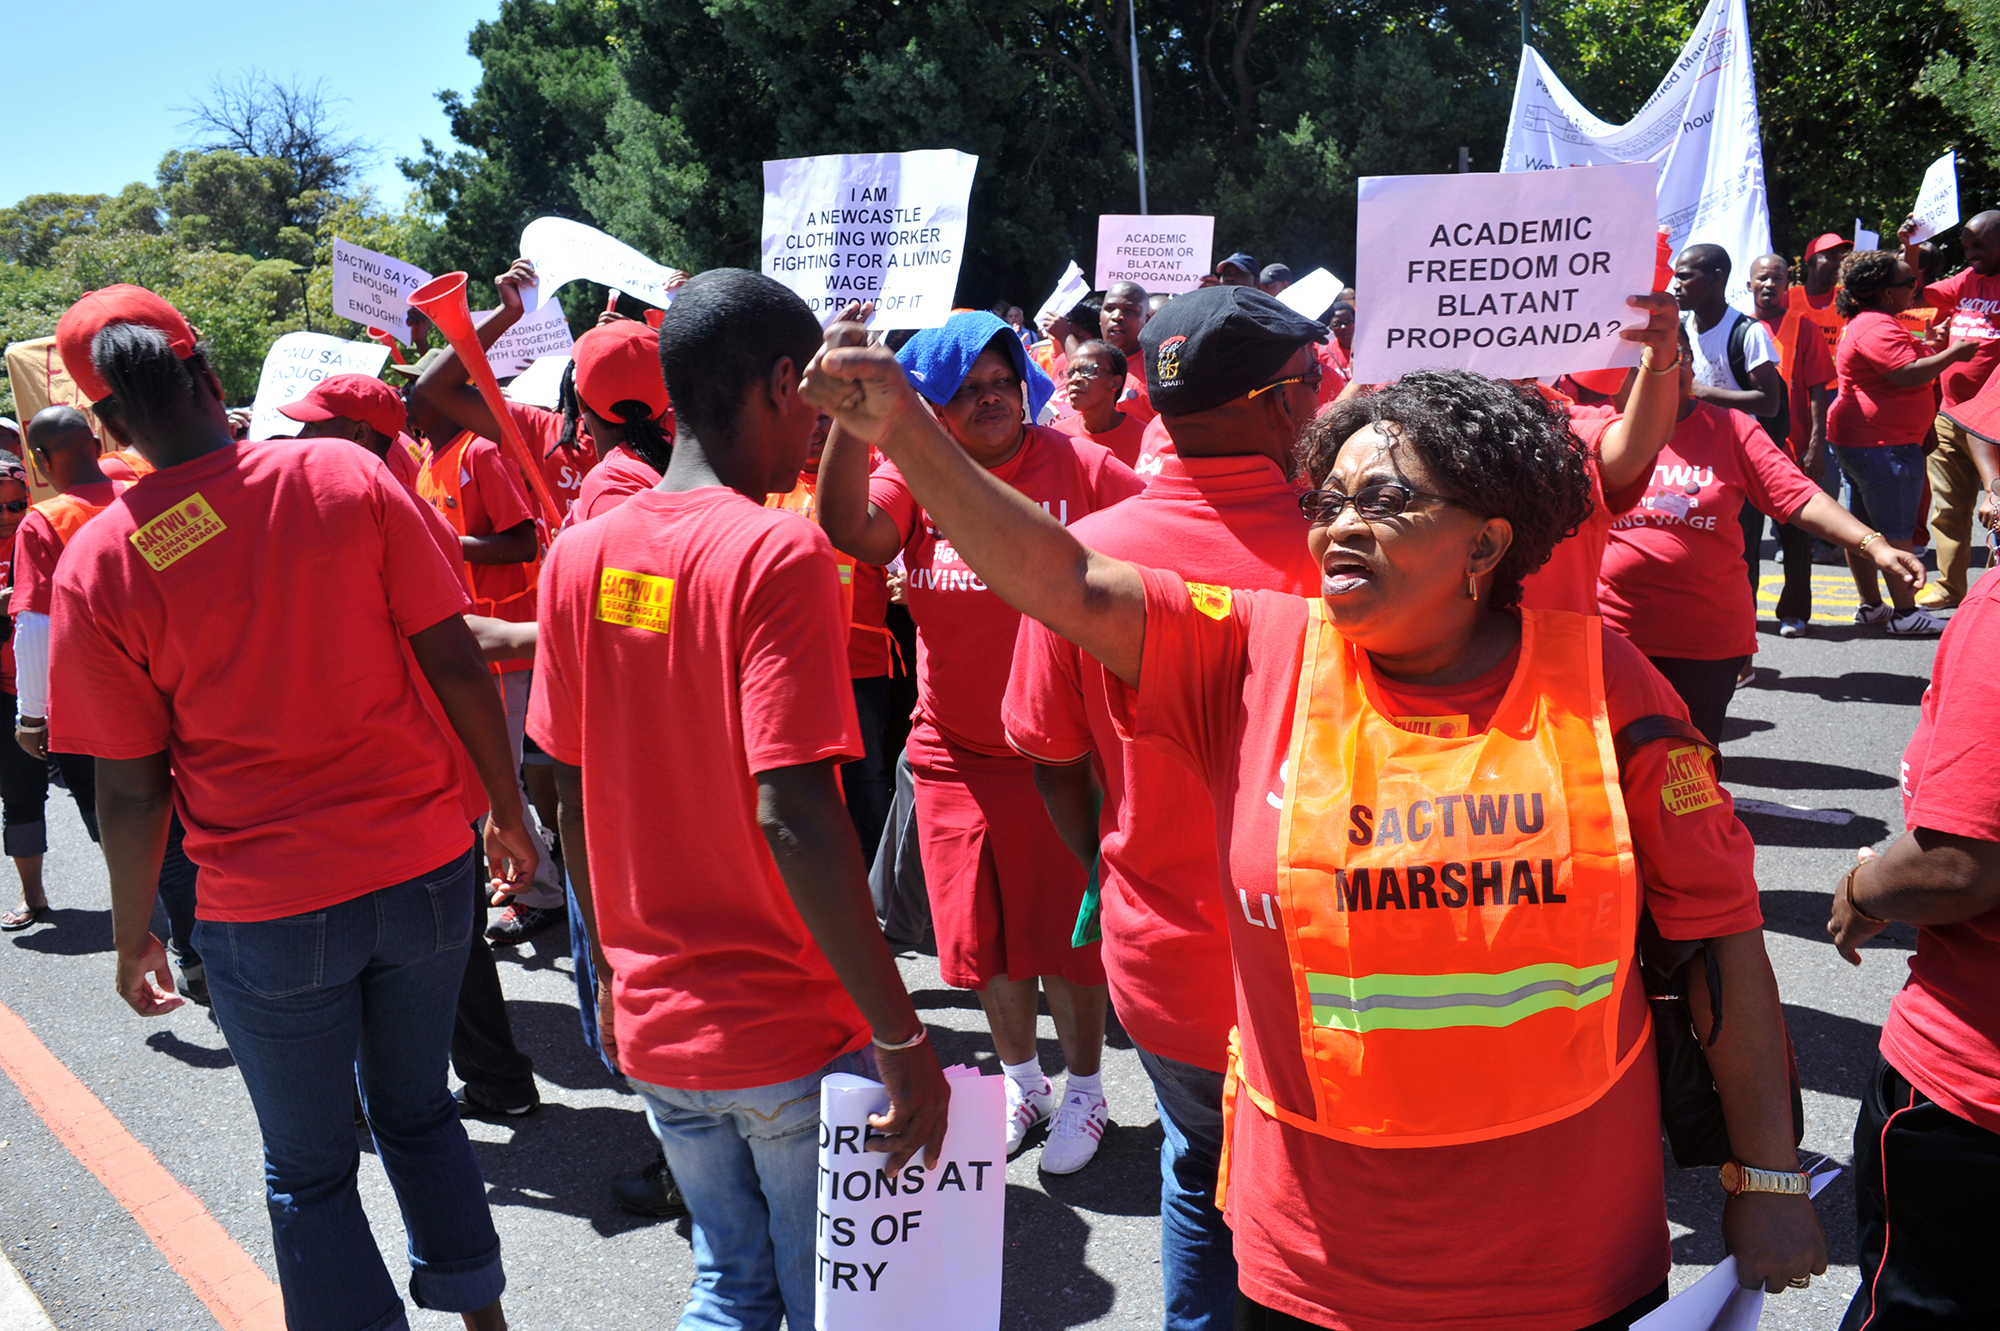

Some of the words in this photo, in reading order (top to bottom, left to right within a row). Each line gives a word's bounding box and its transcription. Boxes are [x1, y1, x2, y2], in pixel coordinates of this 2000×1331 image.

[851, 187, 856, 202] I
[861, 187, 887, 202] AM
[1933, 184, 1953, 203] WANT
[806, 212, 817, 226] A
[821, 207, 921, 225] NEWCASTLE
[1925, 210, 1935, 222] TO
[786, 231, 865, 249] CLOTHING
[870, 228, 940, 246] WORKER
[1125, 234, 1187, 243] ACADEMIC
[1429, 216, 1592, 248] ACADEMIC
[773, 253, 840, 271] FIGHTING
[846, 253, 883, 269] FOR
[887, 254, 898, 268] A
[903, 249, 952, 267] LIVING
[1116, 246, 1174, 257] FREEDOM
[1177, 247, 1194, 257] OR
[337, 250, 381, 276] SACTWU
[383, 268, 419, 289] SAYS
[1127, 259, 1182, 270] BLATANT
[1407, 254, 1559, 284] FREEDOM
[1568, 251, 1611, 276] OR
[352, 272, 398, 298] ENOUGH
[1108, 271, 1199, 282] PROPOGANDA?
[371, 293, 382, 304] IS
[886, 296, 906, 310] OF
[909, 295, 923, 309] IT
[1437, 288, 1579, 317] BLATANT
[349, 299, 404, 328] ENOUGH!!!
[545, 317, 563, 329] OUR
[516, 328, 568, 349] TOGETHER
[1386, 320, 1621, 349] PROPOGANDA?
[511, 348, 535, 358] LOW
[536, 339, 572, 354] WAGES
[1648, 464, 1713, 487] TWU
[137, 510, 187, 552] SACTWU
[1612, 514, 1646, 529] ING
[153, 523, 202, 557] DEMANDS
[203, 518, 212, 526] A
[154, 542, 189, 567] LIVING
[189, 521, 222, 544] WAGE!
[601, 574, 653, 602] SACTWU
[910, 568, 988, 591] LIVING
[599, 609, 632, 623] LIVING
[637, 615, 666, 629] WAGE!
[605, 600, 653, 617] DEMANDS
[655, 609, 662, 618] A
[1668, 793, 1709, 812] LIVING
[1347, 793, 1545, 847] SACTWU
[1335, 858, 1567, 913] MARSHAL
[936, 1161, 992, 1192] AT
[871, 1210, 922, 1246] OF
